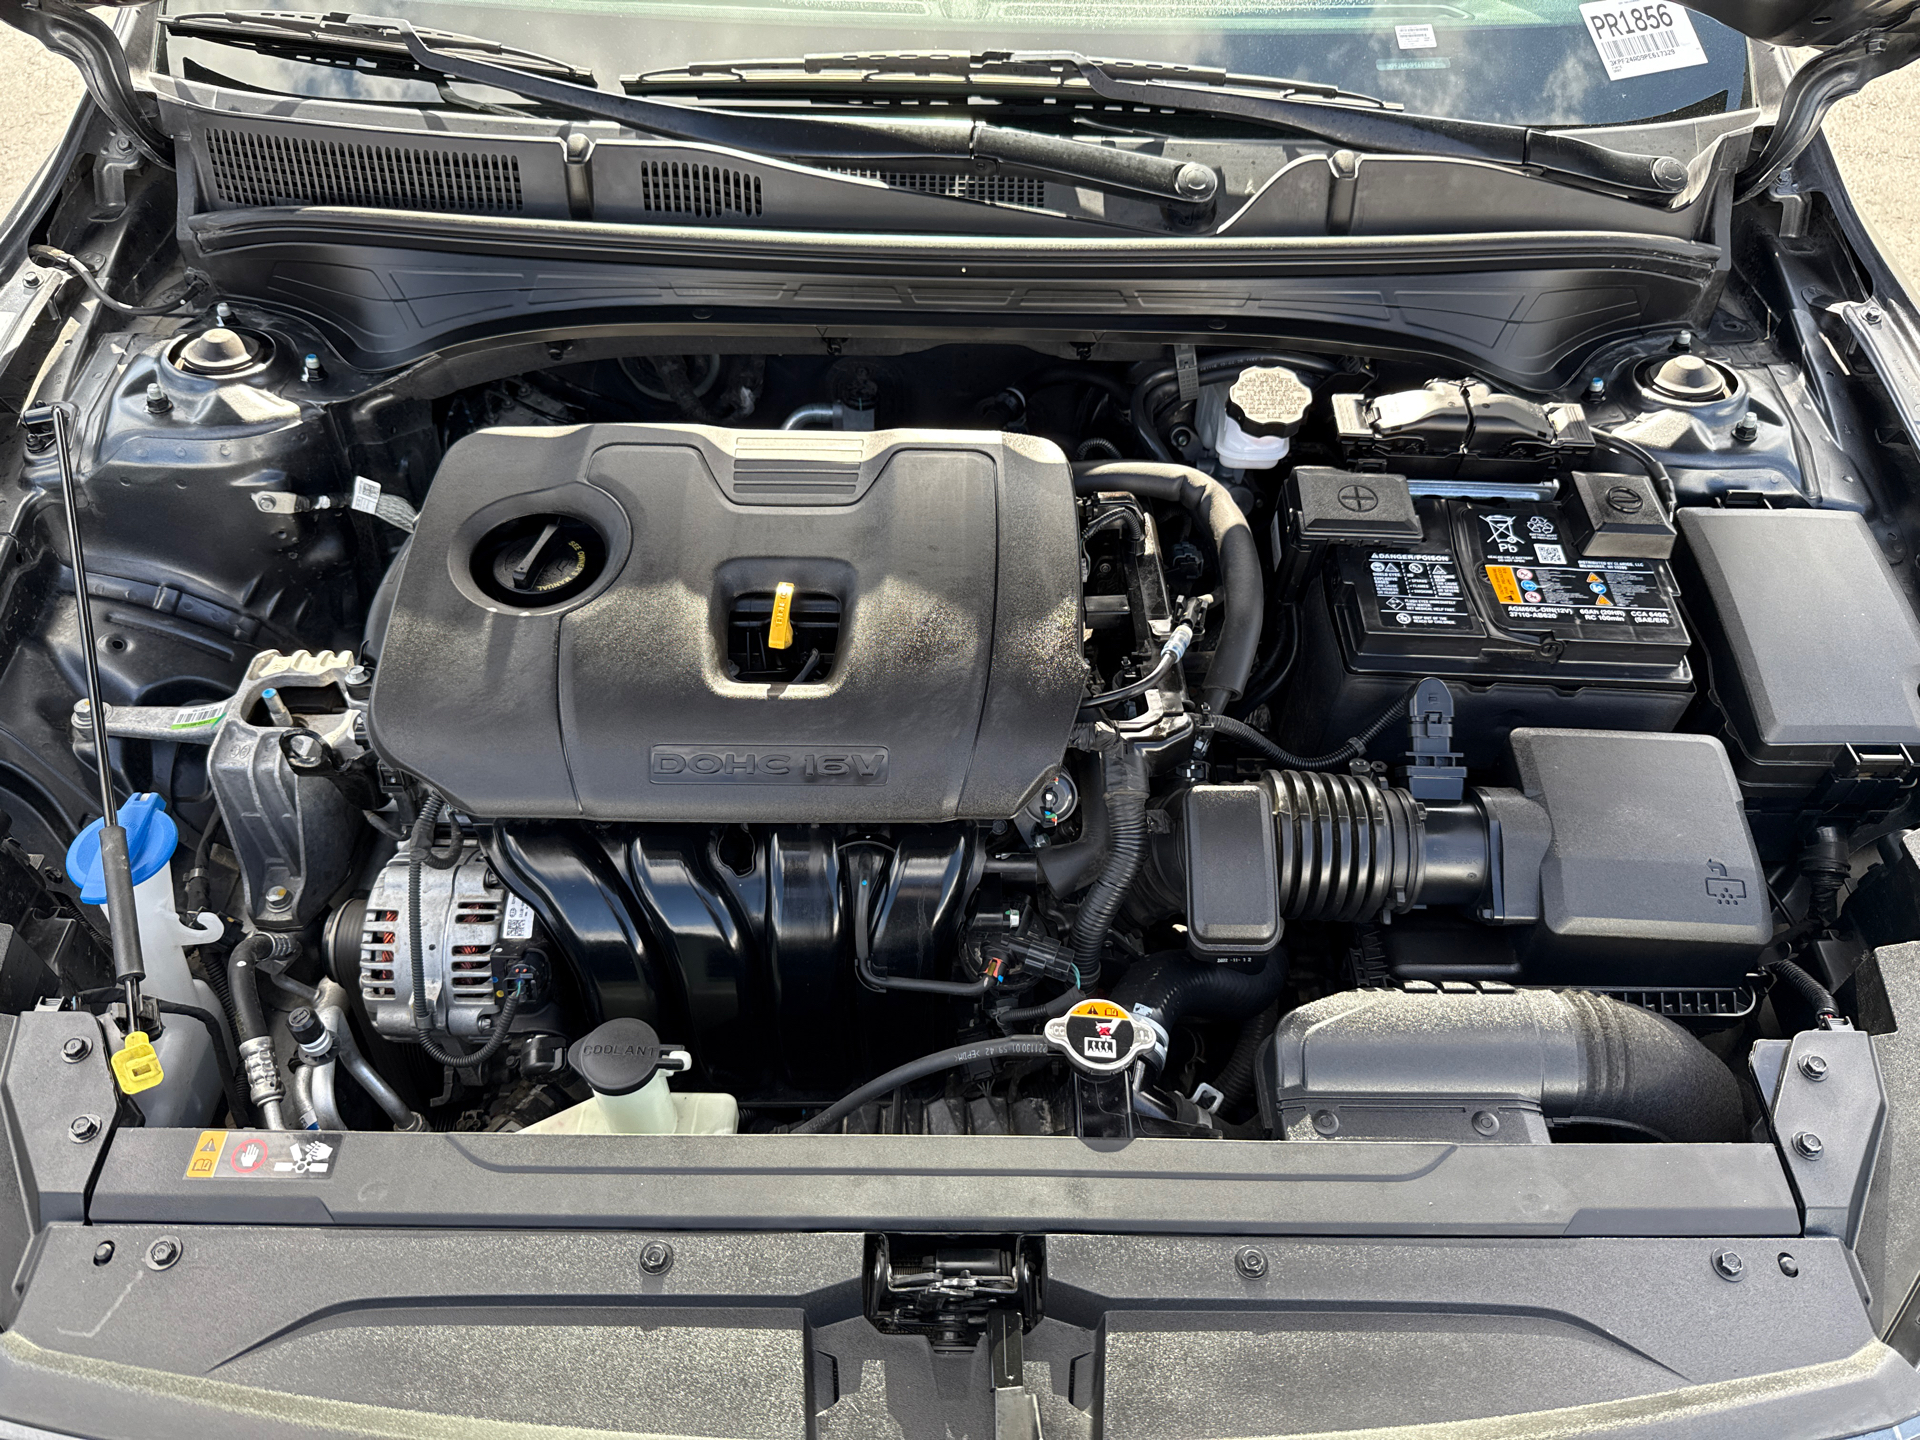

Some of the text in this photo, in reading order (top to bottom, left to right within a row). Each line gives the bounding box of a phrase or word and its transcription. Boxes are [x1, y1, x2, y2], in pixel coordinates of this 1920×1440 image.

[1590, 3, 1673, 39] PR1856
[568, 540, 582, 551] SEE
[1498, 543, 1518, 553] Pb
[1378, 553, 1449, 561] DANGER/POISON
[537, 576, 572, 591] MANUAL
[1600, 609, 1625, 617] (20HR)
[653, 753, 885, 777] DOHC 16V
[583, 1045, 657, 1057] COOLANT
[954, 1048, 981, 1062] >EPDM<
